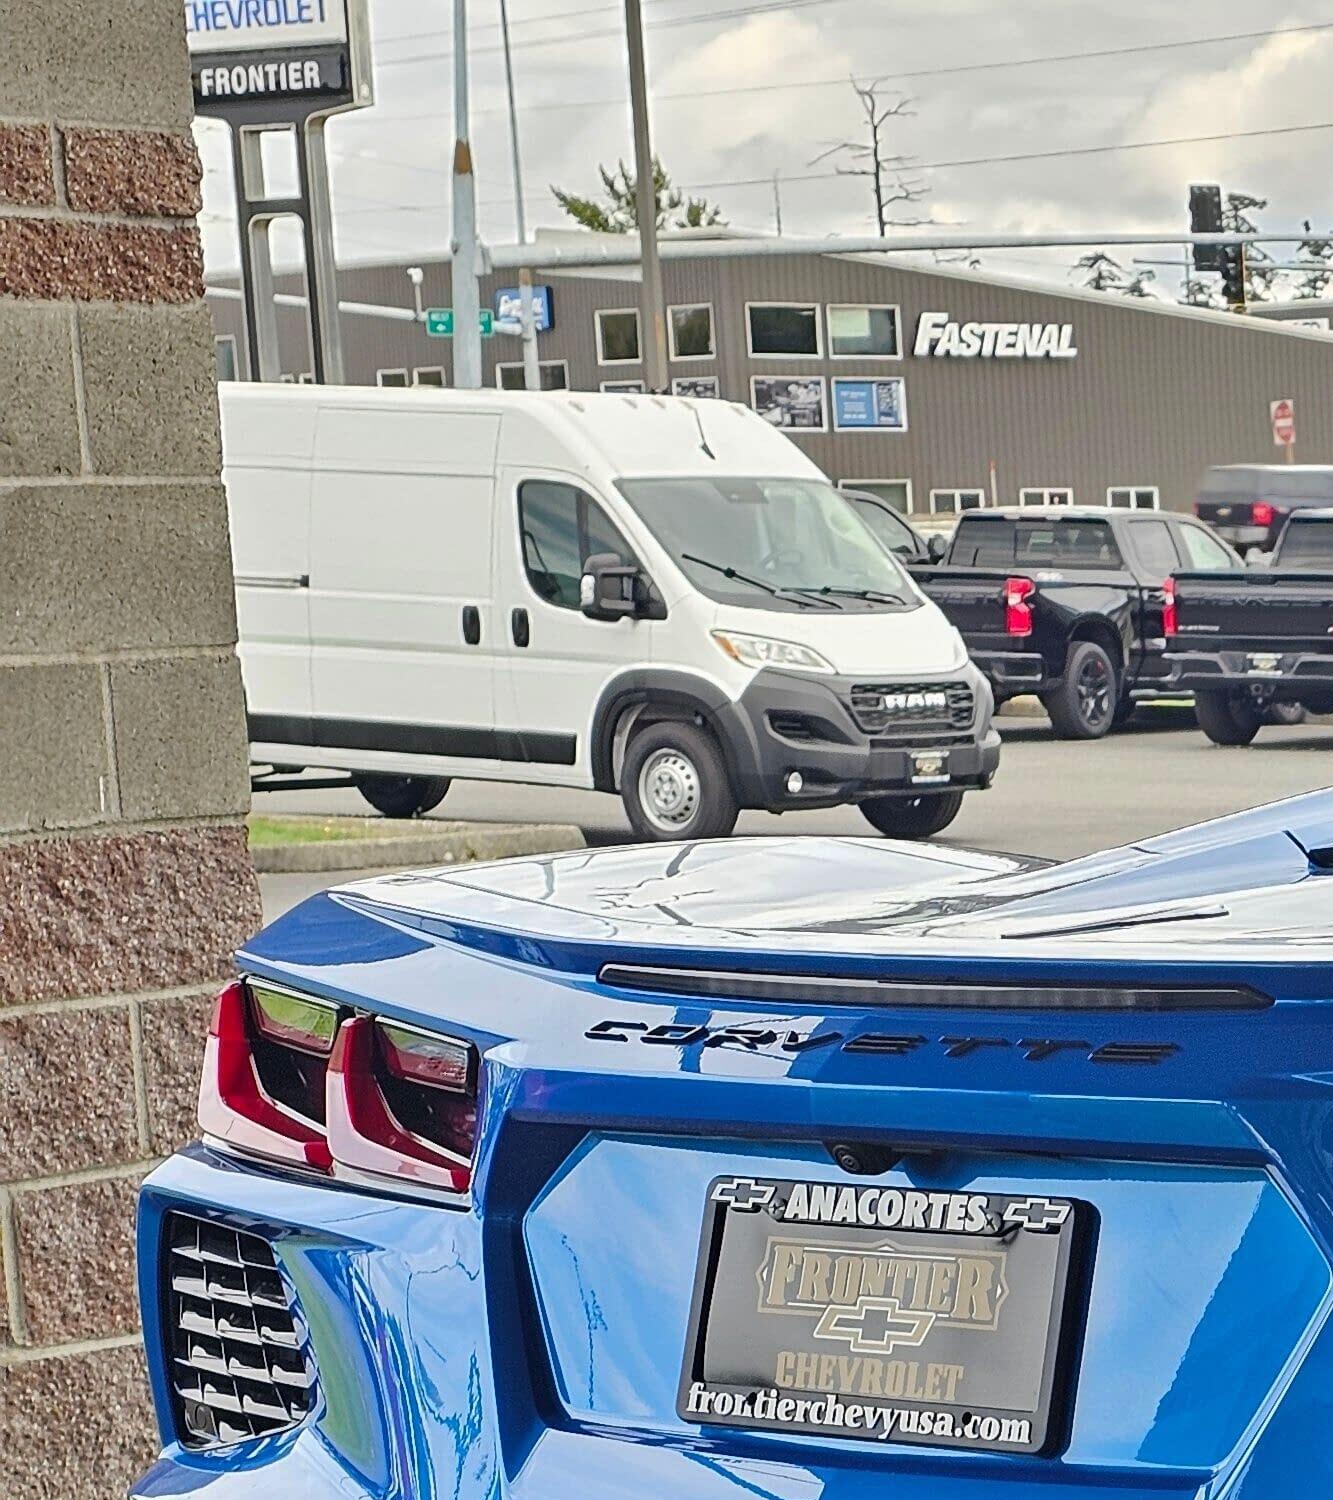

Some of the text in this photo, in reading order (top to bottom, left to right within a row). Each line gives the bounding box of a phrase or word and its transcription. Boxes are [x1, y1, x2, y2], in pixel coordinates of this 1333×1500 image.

[201, 61, 320, 96] FRONTIER
[914, 312, 1078, 358] FASTENAL
[885, 692, 946, 709] RAM
[585, 1020, 1183, 1065] CORVETTE
[784, 1184, 989, 1233] ANACORTES
[767, 1244, 996, 1321] FRONTIER
[775, 1351, 964, 1401] CHEVROLET
[686, 1383, 1031, 1443] frontierchevyusa.com
